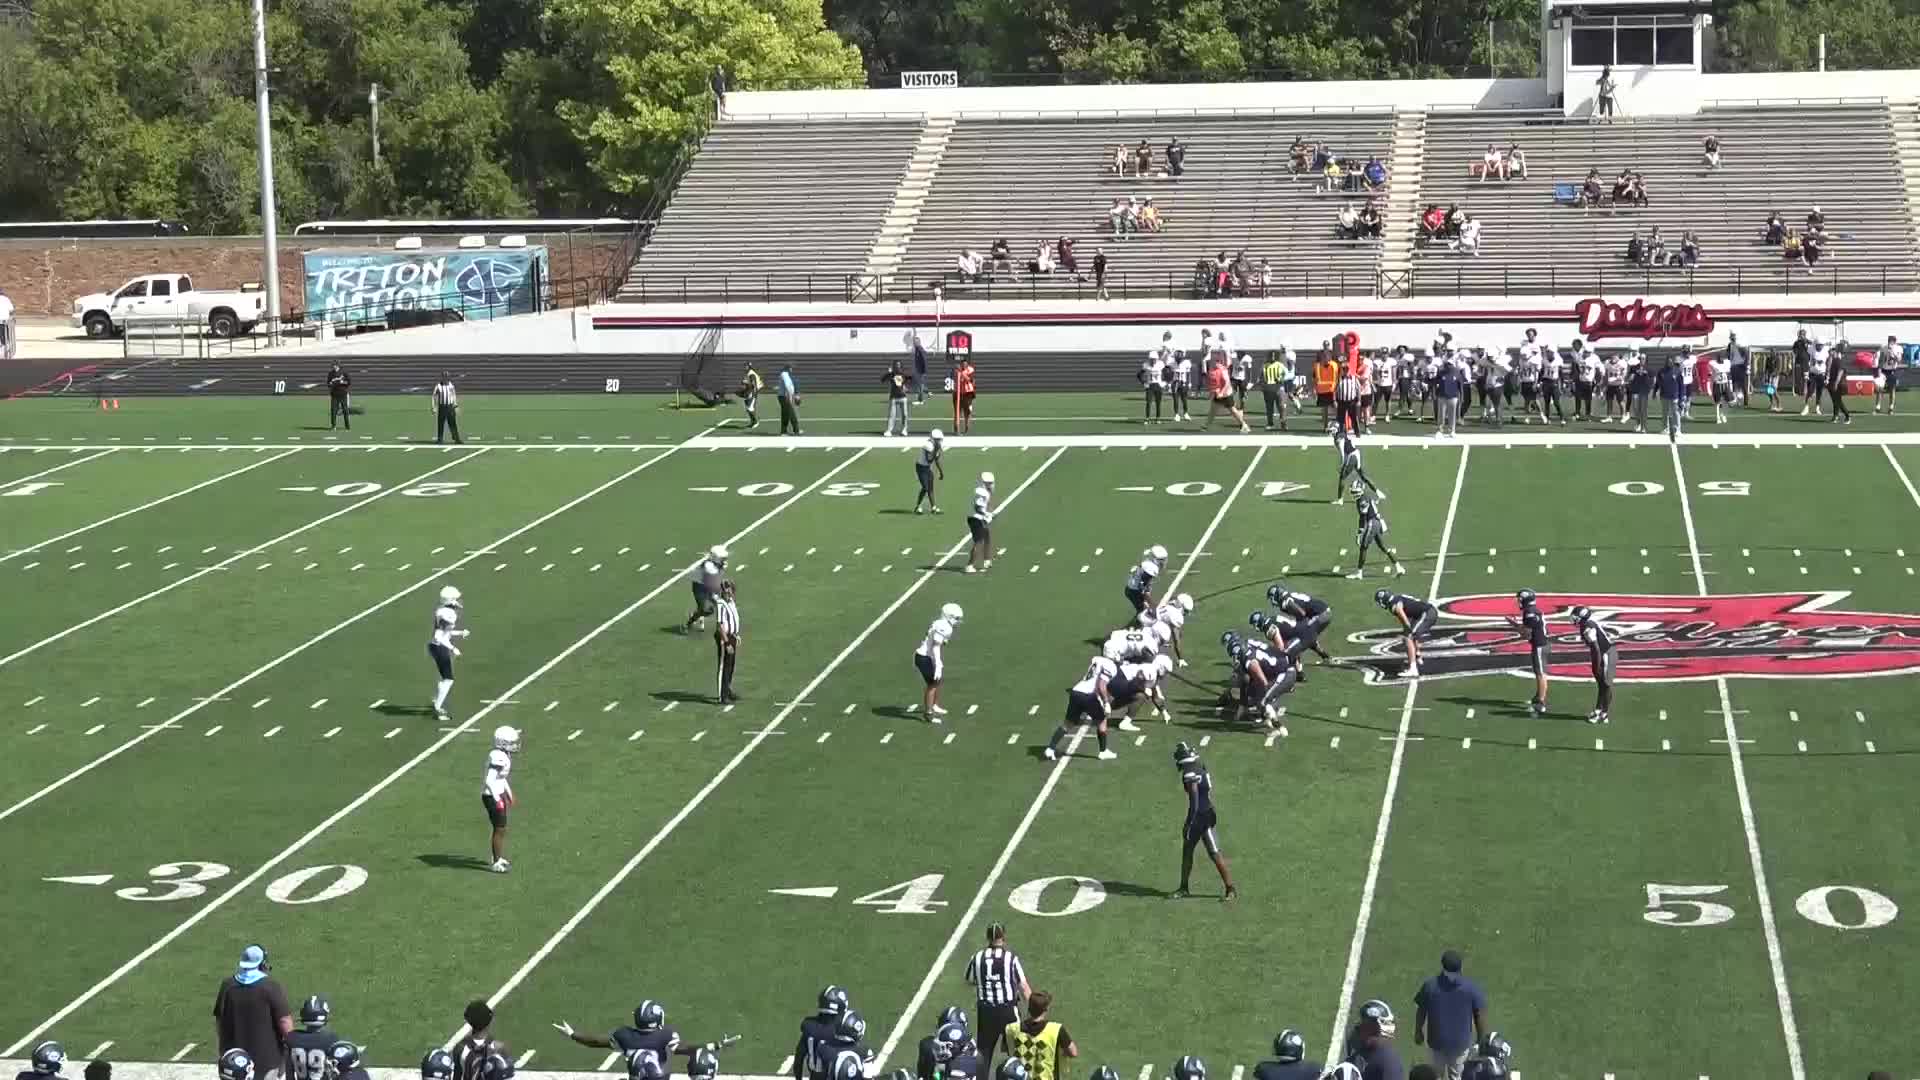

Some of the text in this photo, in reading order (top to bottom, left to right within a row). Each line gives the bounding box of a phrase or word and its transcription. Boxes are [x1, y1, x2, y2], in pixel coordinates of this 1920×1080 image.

[903, 73, 956, 86] VISITORS
[308, 257, 446, 294] TRITON
[1575, 298, 1714, 341] Dodgers
[605, 379, 620, 392] 20
[116, 862, 368, 904] 30
[852, 874, 1107, 916] 40
[1643, 883, 1898, 929] 50
